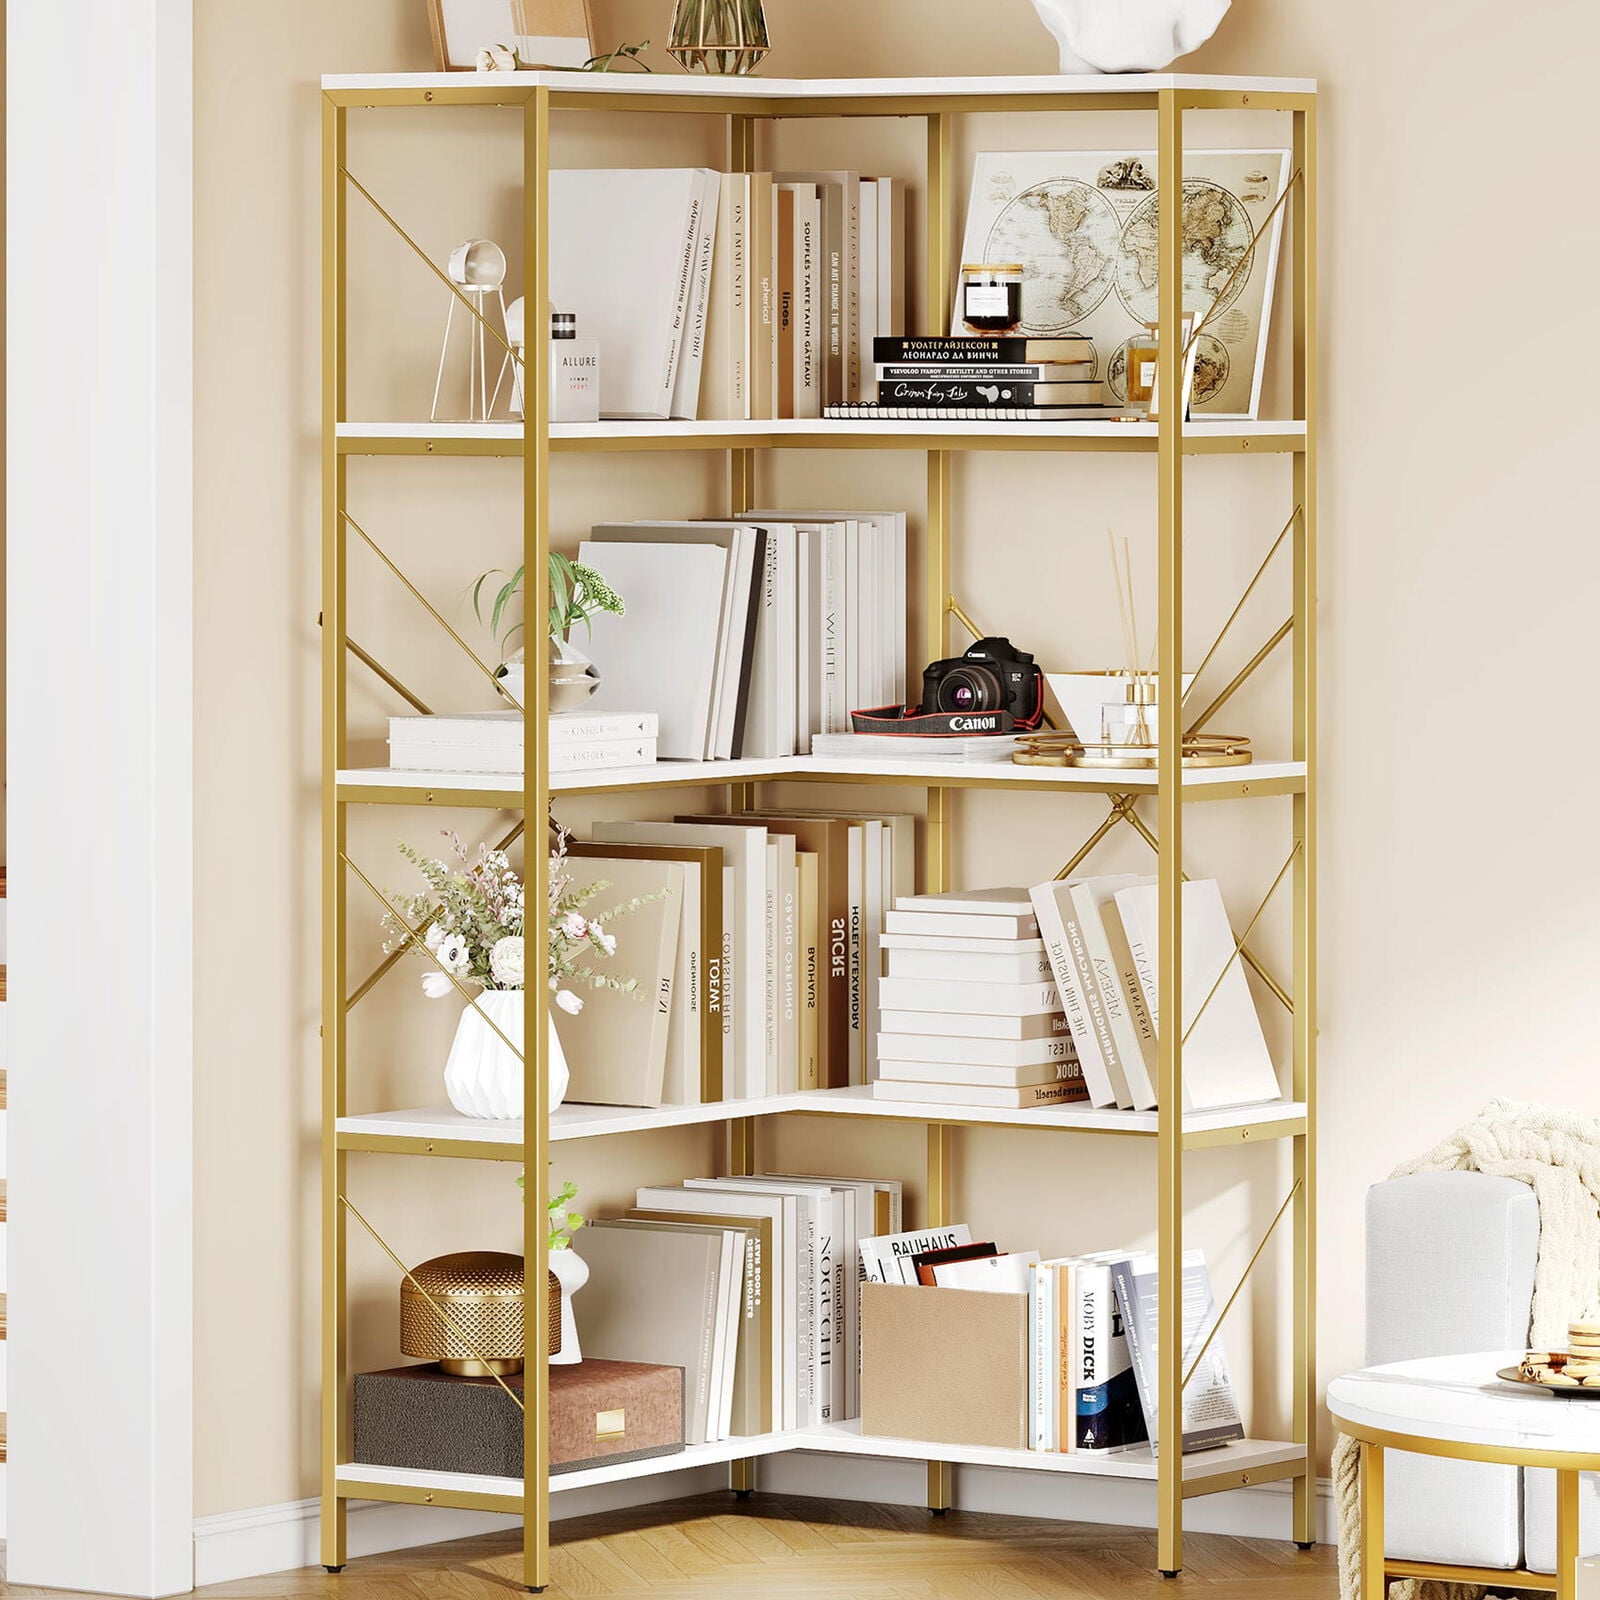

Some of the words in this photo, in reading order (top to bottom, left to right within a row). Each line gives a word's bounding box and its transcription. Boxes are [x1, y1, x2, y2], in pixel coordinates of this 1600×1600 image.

[735, 205, 742, 224] ON
[679, 244, 692, 302] sustainable
[687, 199, 699, 241] lifestyle
[804, 221, 812, 271] SOUFFLÉS
[831, 252, 839, 267] CAN
[831, 268, 839, 282] ART
[760, 277, 771, 324] spherical
[781, 291, 791, 331] lines.
[831, 283, 839, 311] CHANGE
[831, 312, 839, 326] THE
[831, 327, 839, 356] WORLD?
[902, 351, 950, 360] ЛЕОНАРДО
[951, 351, 964, 360] ДА
[967, 351, 999, 360] ВИНЧИ
[911, 341, 943, 350] УОЛТЕР
[944, 340, 990, 350] АЙЗЕКСОН
[562, 356, 596, 367] ALLURE
[804, 340, 812, 388] GÂTEAUX
[826, 612, 835, 681] WHITE
[949, 716, 996, 731] Canon
[892, 1233, 958, 1256] BAUHAUS
[820, 1236, 831, 1365] NOGUCHI
[835, 1263, 843, 1344] Remodelista
[1083, 1290, 1095, 1336] MOBY
[1083, 1336, 1095, 1381] DICK
